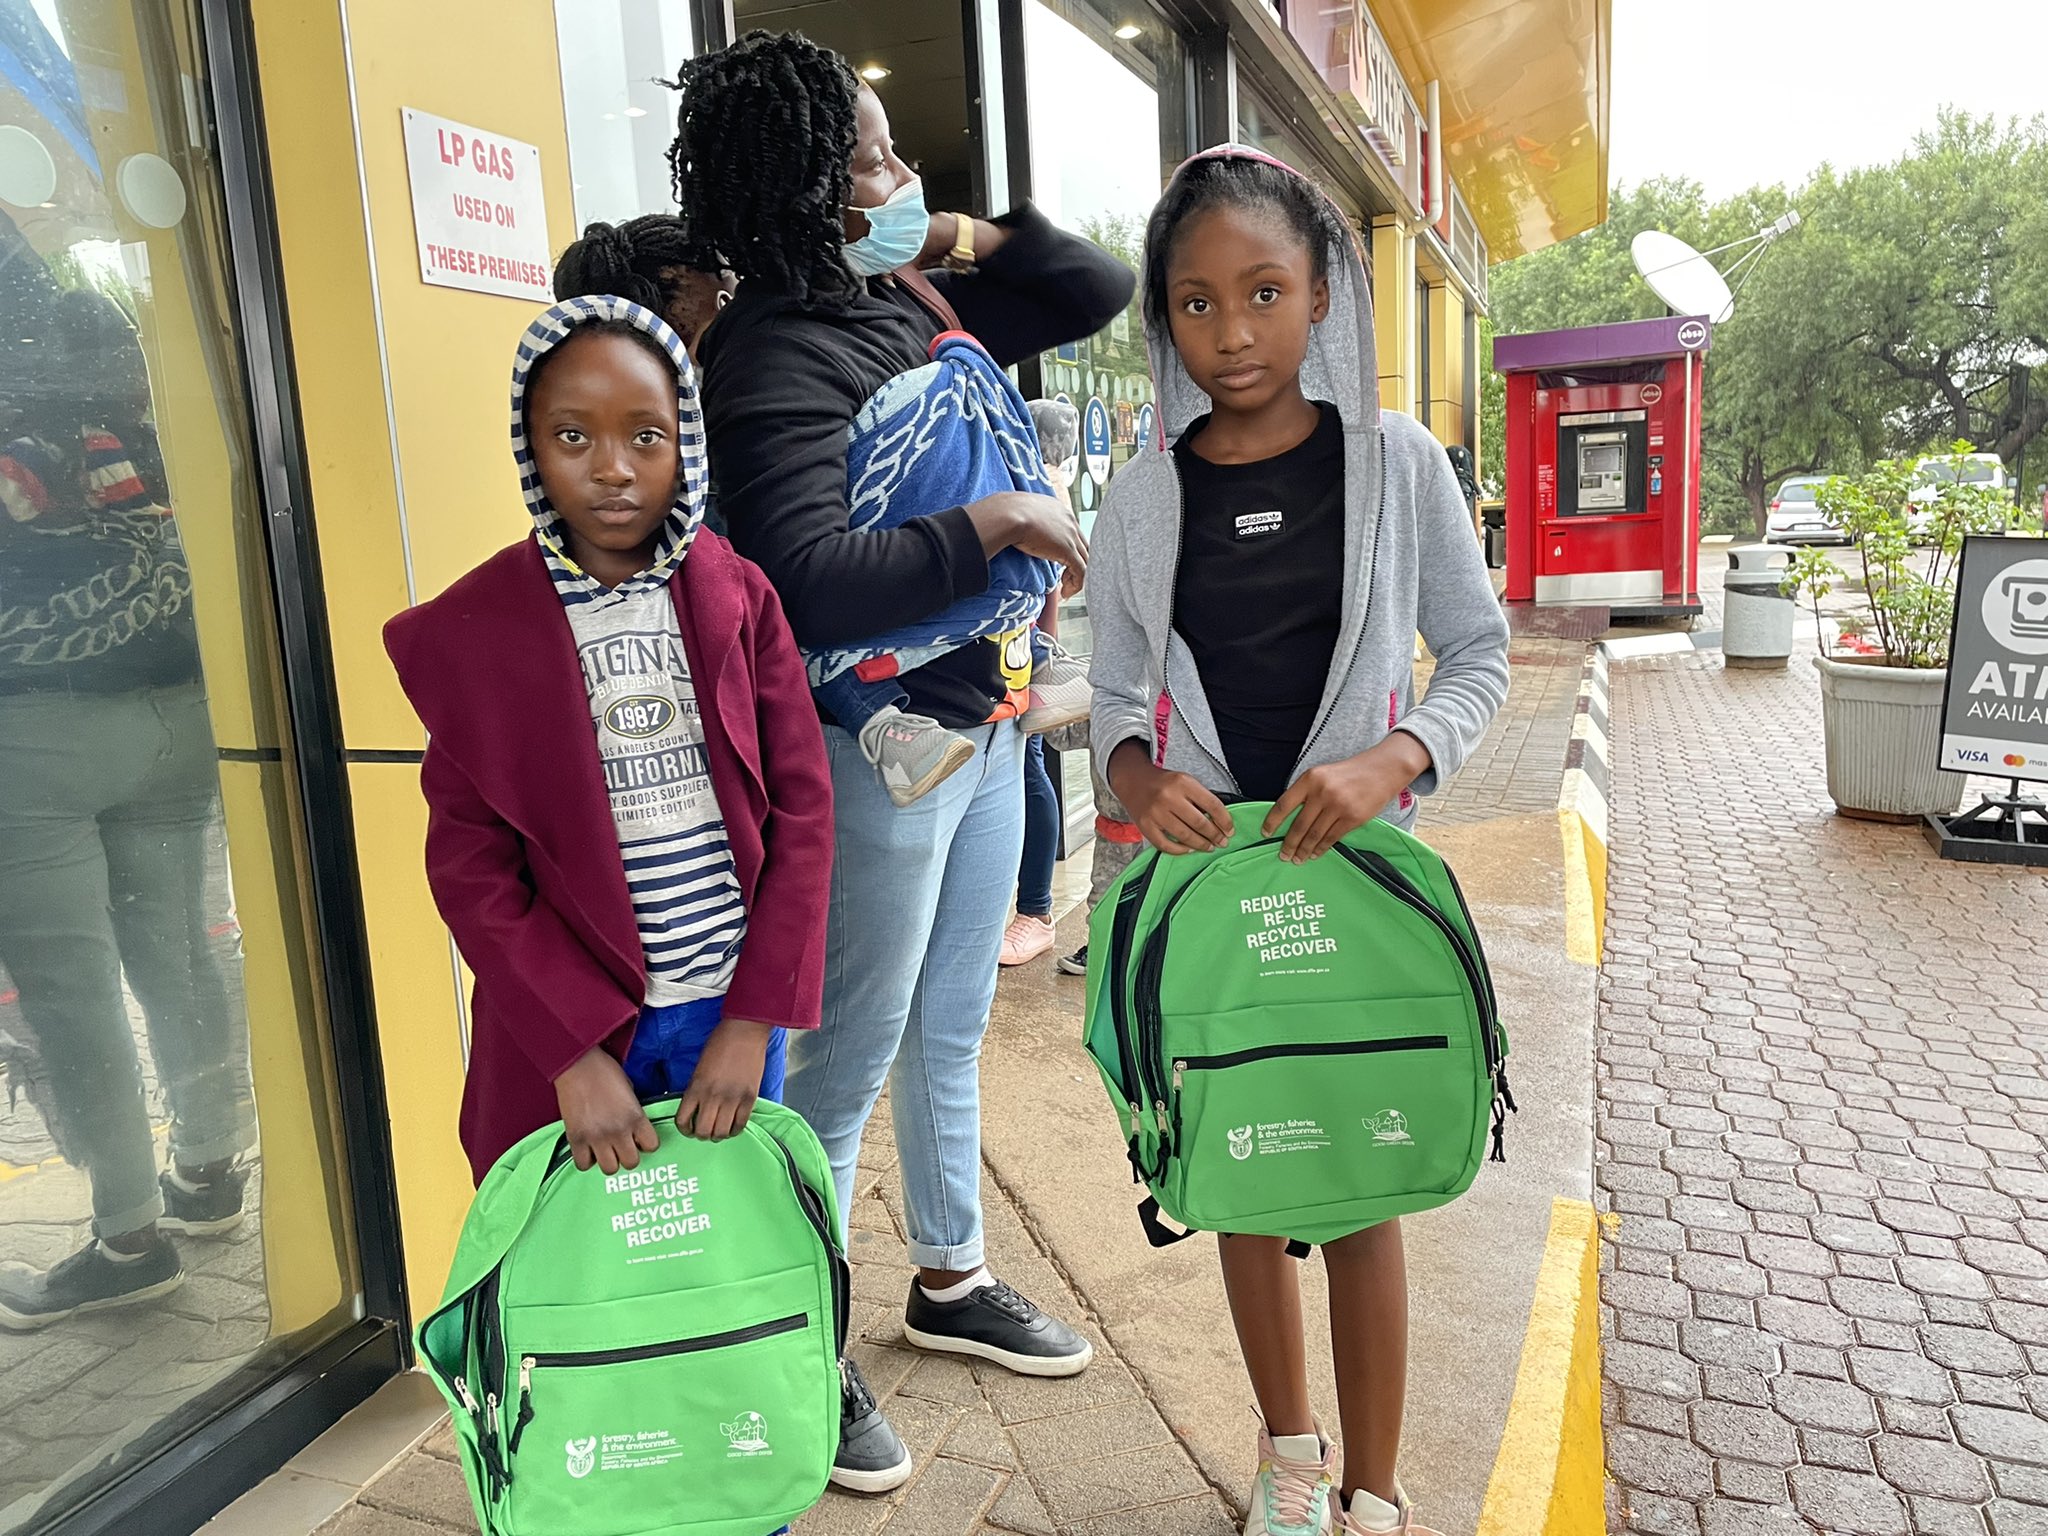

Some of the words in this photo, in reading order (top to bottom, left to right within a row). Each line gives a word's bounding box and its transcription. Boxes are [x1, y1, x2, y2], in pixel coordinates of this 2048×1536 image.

[438, 128, 465, 166] LP
[471, 139, 514, 181] GAS
[452, 193, 492, 224] USED
[495, 204, 515, 229] ON
[427, 243, 476, 275] THESE
[479, 254, 546, 287] PREMISES
[1681, 329, 1702, 339] absa
[1238, 515, 1269, 525] adidas
[1238, 525, 1270, 535] adidas
[615, 701, 662, 731] 1987
[1955, 748, 1989, 763] VISA
[621, 791, 657, 807] GOODS
[616, 807, 658, 822] LIMITED
[1240, 889, 1306, 914] REDUCE
[1263, 903, 1326, 927] RE-USE
[1246, 921, 1321, 949] RECYCLE
[1260, 938, 1338, 963] RECOVER
[1265, 1130, 1278, 1138] the
[605, 1163, 679, 1194] REDUCE
[631, 1177, 700, 1207] RE-USE
[611, 1197, 695, 1232] RECYCLE
[626, 1213, 712, 1248] RECOVER
[601, 1443, 608, 1452] &
[611, 1443, 624, 1451] the
